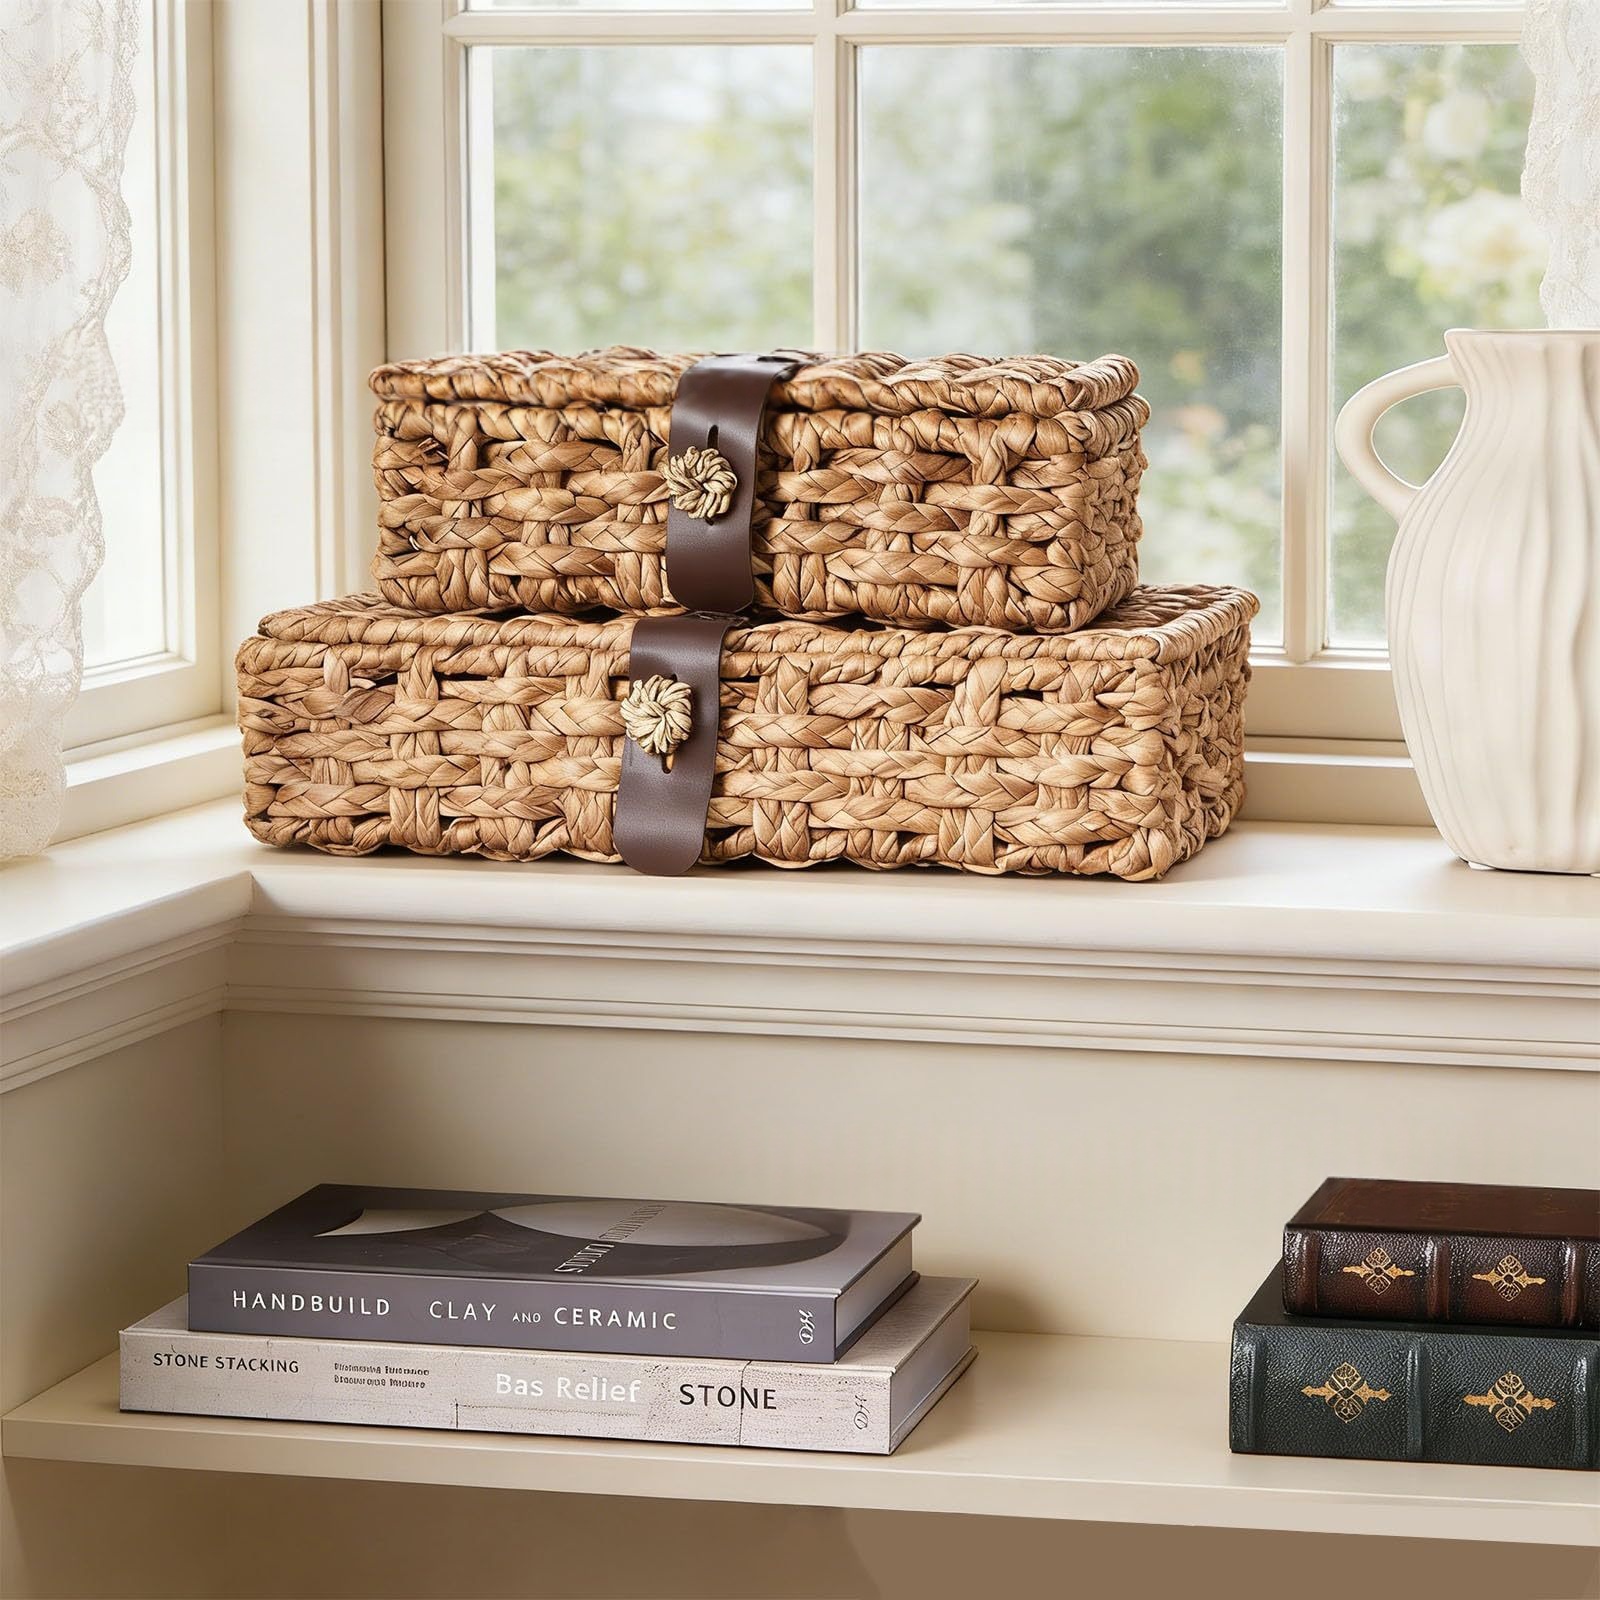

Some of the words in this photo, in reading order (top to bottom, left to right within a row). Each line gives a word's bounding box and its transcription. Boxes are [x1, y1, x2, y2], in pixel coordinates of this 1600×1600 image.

[233, 1290, 390, 1316] HANDBUILD
[429, 1300, 497, 1321] CLAY
[554, 1307, 677, 1330] CERAMIC
[153, 1352, 209, 1368] STONE
[215, 1356, 299, 1373] STACKING
[496, 1373, 544, 1397] Bas
[557, 1376, 642, 1402] Relief
[679, 1383, 777, 1410] STONE
